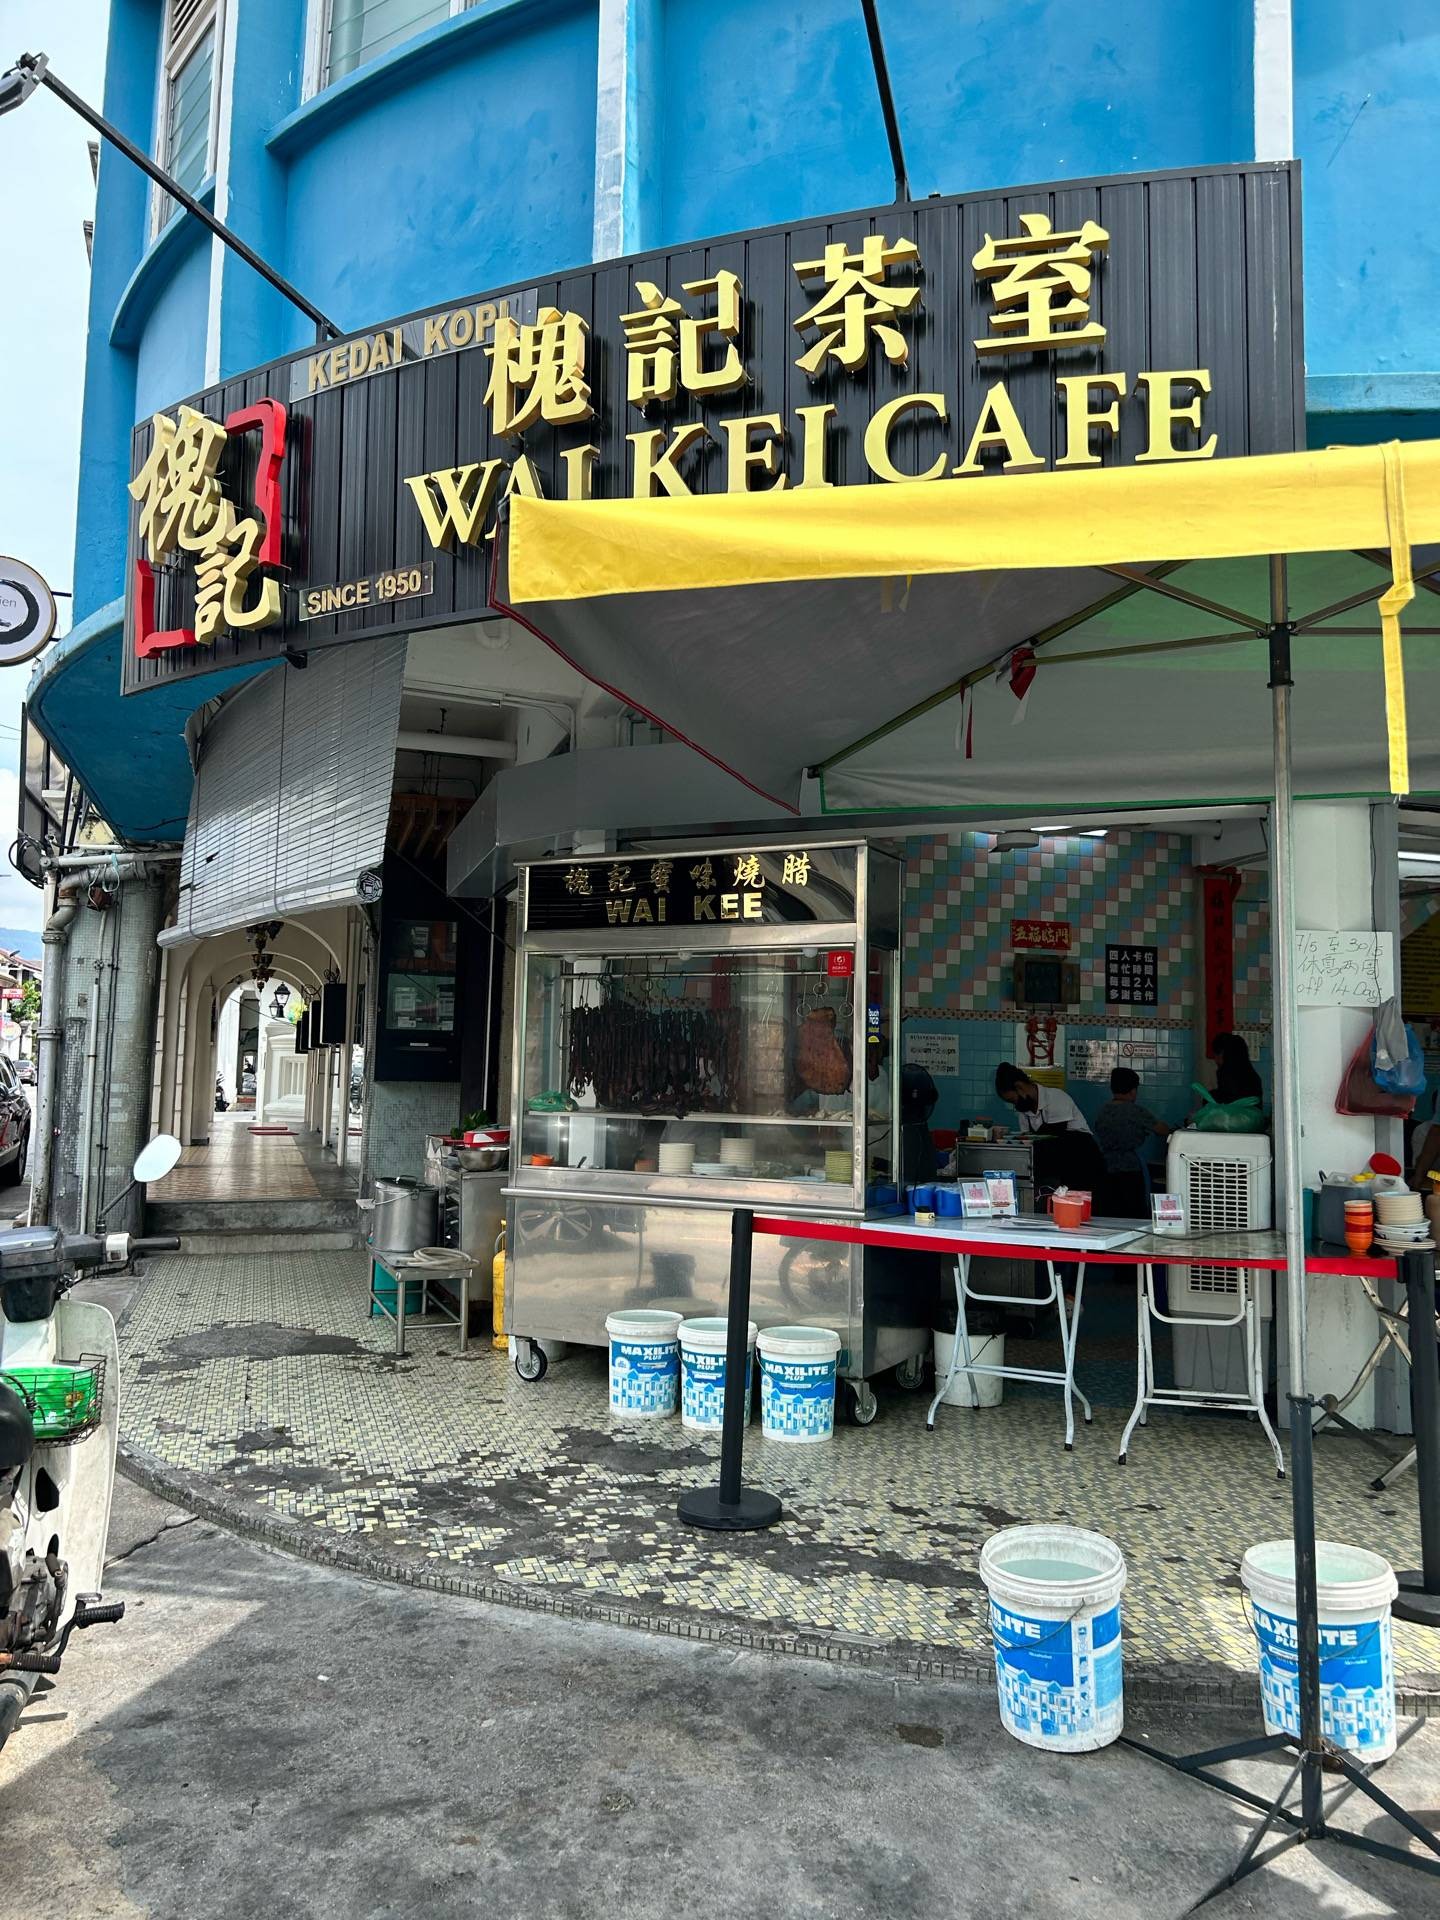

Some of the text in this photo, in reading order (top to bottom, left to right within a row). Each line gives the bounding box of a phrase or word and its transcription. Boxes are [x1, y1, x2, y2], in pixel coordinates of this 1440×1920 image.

[484, 213, 1110, 436] 槐記茶室
[307, 330, 403, 392] KEDAI
[626, 403, 838, 498] KEI
[864, 369, 1219, 483] CAFE
[307, 569, 423, 615] SINCE 1950
[605, 892, 763, 923] WAI KEE
[1331, 977, 1350, 996] 14
[682, 1352, 727, 1367] MAXILI
[765, 1362, 829, 1377] MAXILITE
[1254, 1608, 1358, 1646] MAXIITE
[1275, 1634, 1298, 1649] PLU
